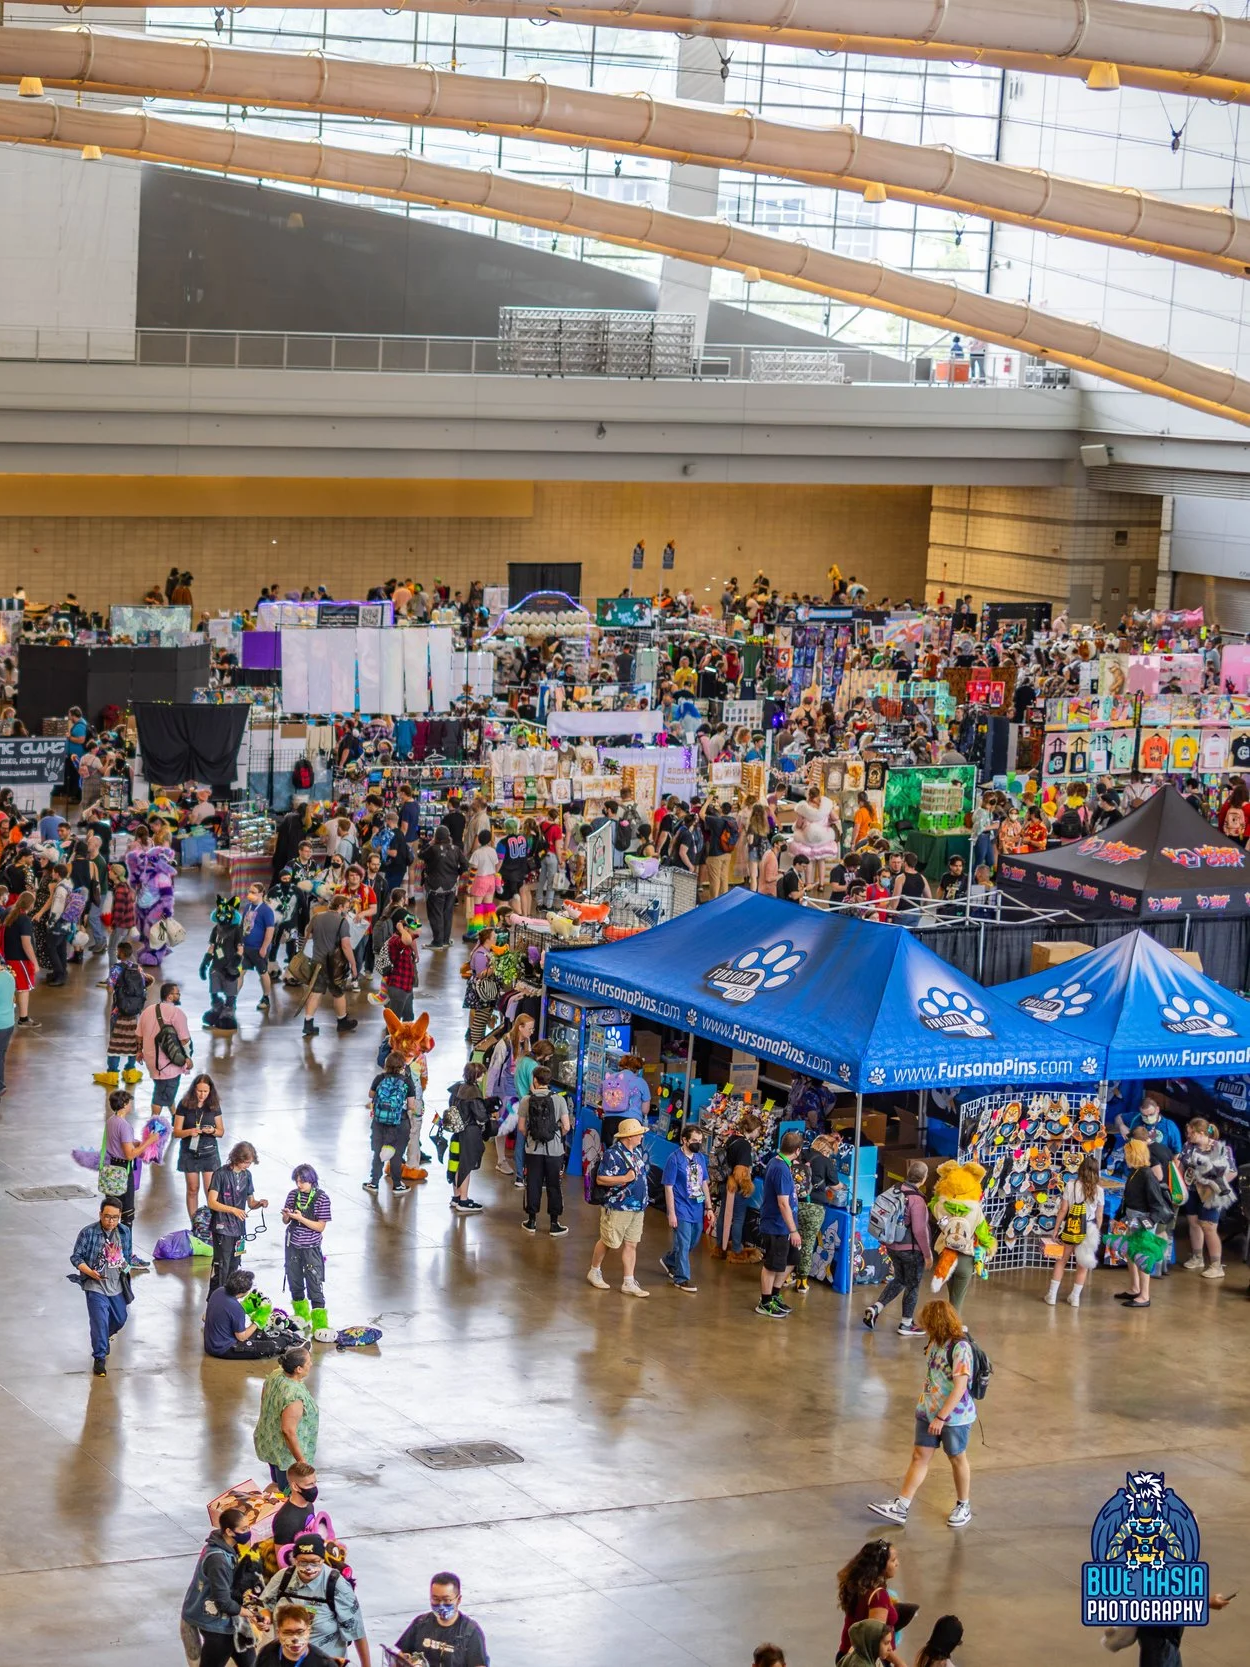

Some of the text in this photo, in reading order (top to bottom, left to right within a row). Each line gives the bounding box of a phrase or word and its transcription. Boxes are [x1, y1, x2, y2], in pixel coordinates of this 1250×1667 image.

[20, 742, 66, 755] CLAWS
[508, 836, 526, 858] 02
[708, 968, 756, 984] FURSONA
[564, 972, 681, 1021] www.FursonaPins.com
[1020, 997, 1060, 1012] FURSONA
[925, 1014, 963, 1029] FURSONA
[1167, 1019, 1207, 1033] FURSONA
[701, 1016, 833, 1075] www.FursonaPins.com
[894, 1057, 1073, 1081] www.FursonaPins.com
